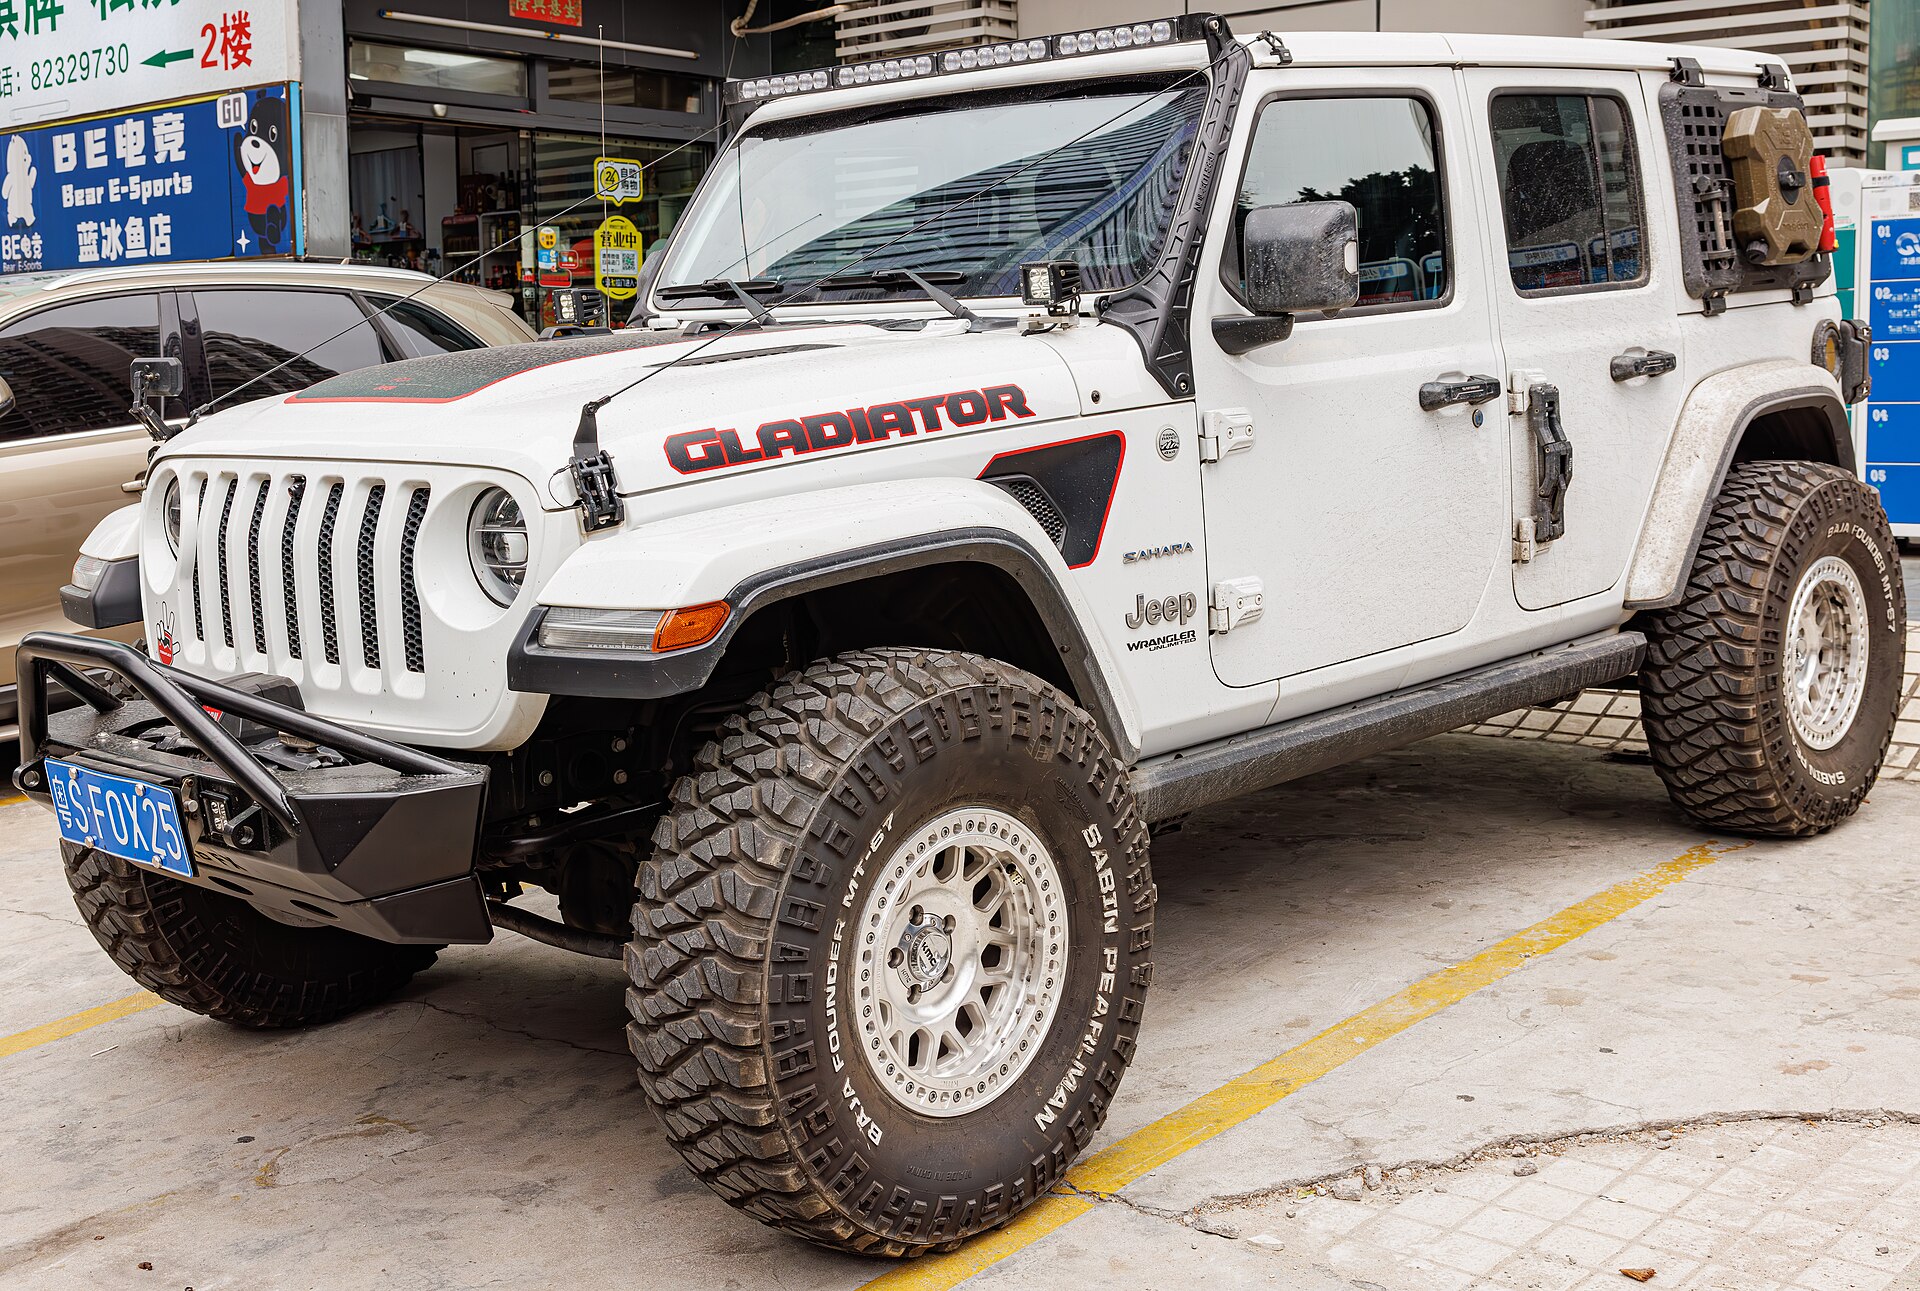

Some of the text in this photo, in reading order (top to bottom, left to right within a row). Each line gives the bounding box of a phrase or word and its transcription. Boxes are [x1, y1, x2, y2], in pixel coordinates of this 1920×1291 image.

[200, 10, 252, 71] 2楼
[31, 43, 129, 90] 82329730
[222, 98, 242, 124] GO
[52, 112, 187, 174] BE电竞
[61, 172, 192, 208] Bear E-Sports
[605, 170, 615, 184] 24
[77, 213, 172, 263] 蓝冰鱼店
[600, 231, 636, 248] 营业中
[1877, 225, 1891, 238] 01
[2, 262, 16, 273] Bear
[1875, 287, 1890, 300] 02
[1874, 348, 1889, 361] 03
[664, 383, 1036, 475] GLADIATOR
[1872, 409, 1888, 421] 04
[1870, 469, 1887, 482] 05
[1122, 541, 1194, 564] SAHARA
[1827, 522, 1896, 633] BAJA FOUNDER MT-67
[1125, 591, 1197, 629] Jeep
[1126, 629, 1196, 652] WRANGLER
[1148, 637, 1197, 652] UNLIMITED
[842, 811, 895, 909] MT-67
[1082, 822, 1119, 934] SABIN
[825, 918, 846, 1074] FOUNDER
[842, 1076, 884, 1146] BAJA
